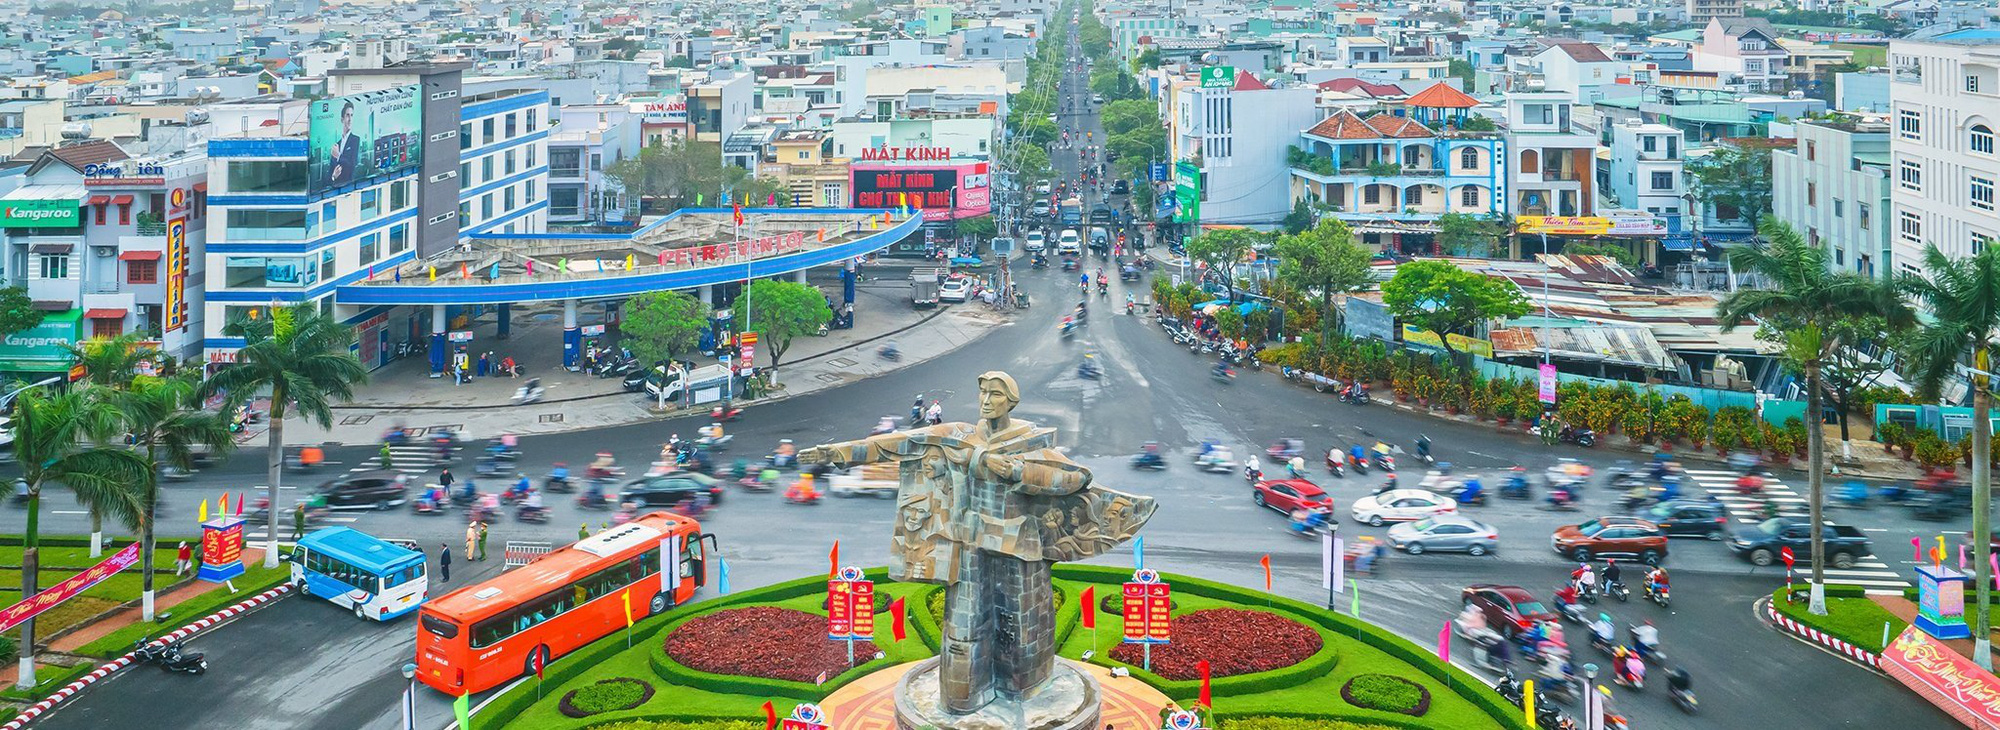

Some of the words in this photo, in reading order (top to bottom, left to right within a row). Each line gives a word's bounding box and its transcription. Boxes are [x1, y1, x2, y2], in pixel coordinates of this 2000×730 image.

[905, 145, 950, 161] KÍNH
[905, 172, 934, 188] KÍNH
[662, 242, 730, 266] PETRO
